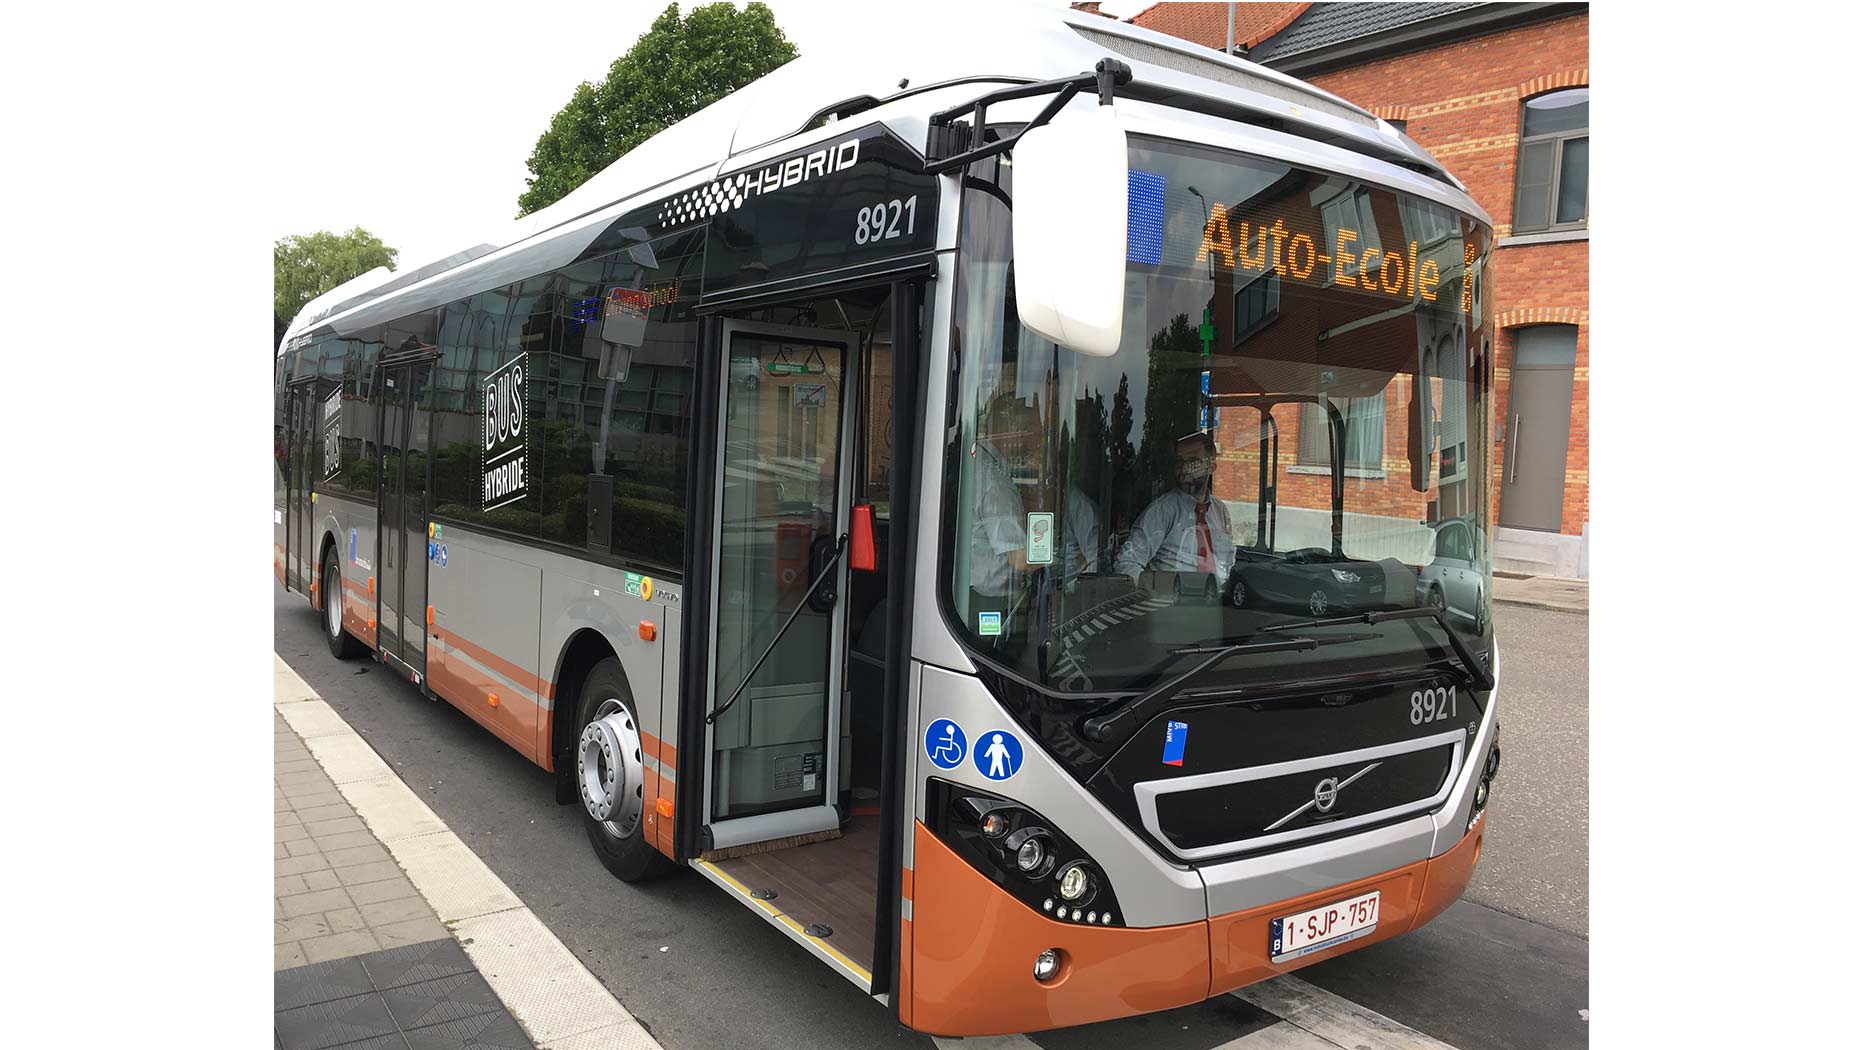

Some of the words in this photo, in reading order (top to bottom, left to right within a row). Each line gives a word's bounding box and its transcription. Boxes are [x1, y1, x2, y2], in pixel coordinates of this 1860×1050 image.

[743, 138, 860, 199] HYBRID
[855, 195, 917, 245] 8921
[1196, 201, 1440, 302] Auto-Ecole
[486, 365, 523, 451] BUS
[485, 456, 525, 502] HYBRIDE
[1410, 685, 1458, 726] 8921
[1273, 939, 1281, 951] B
